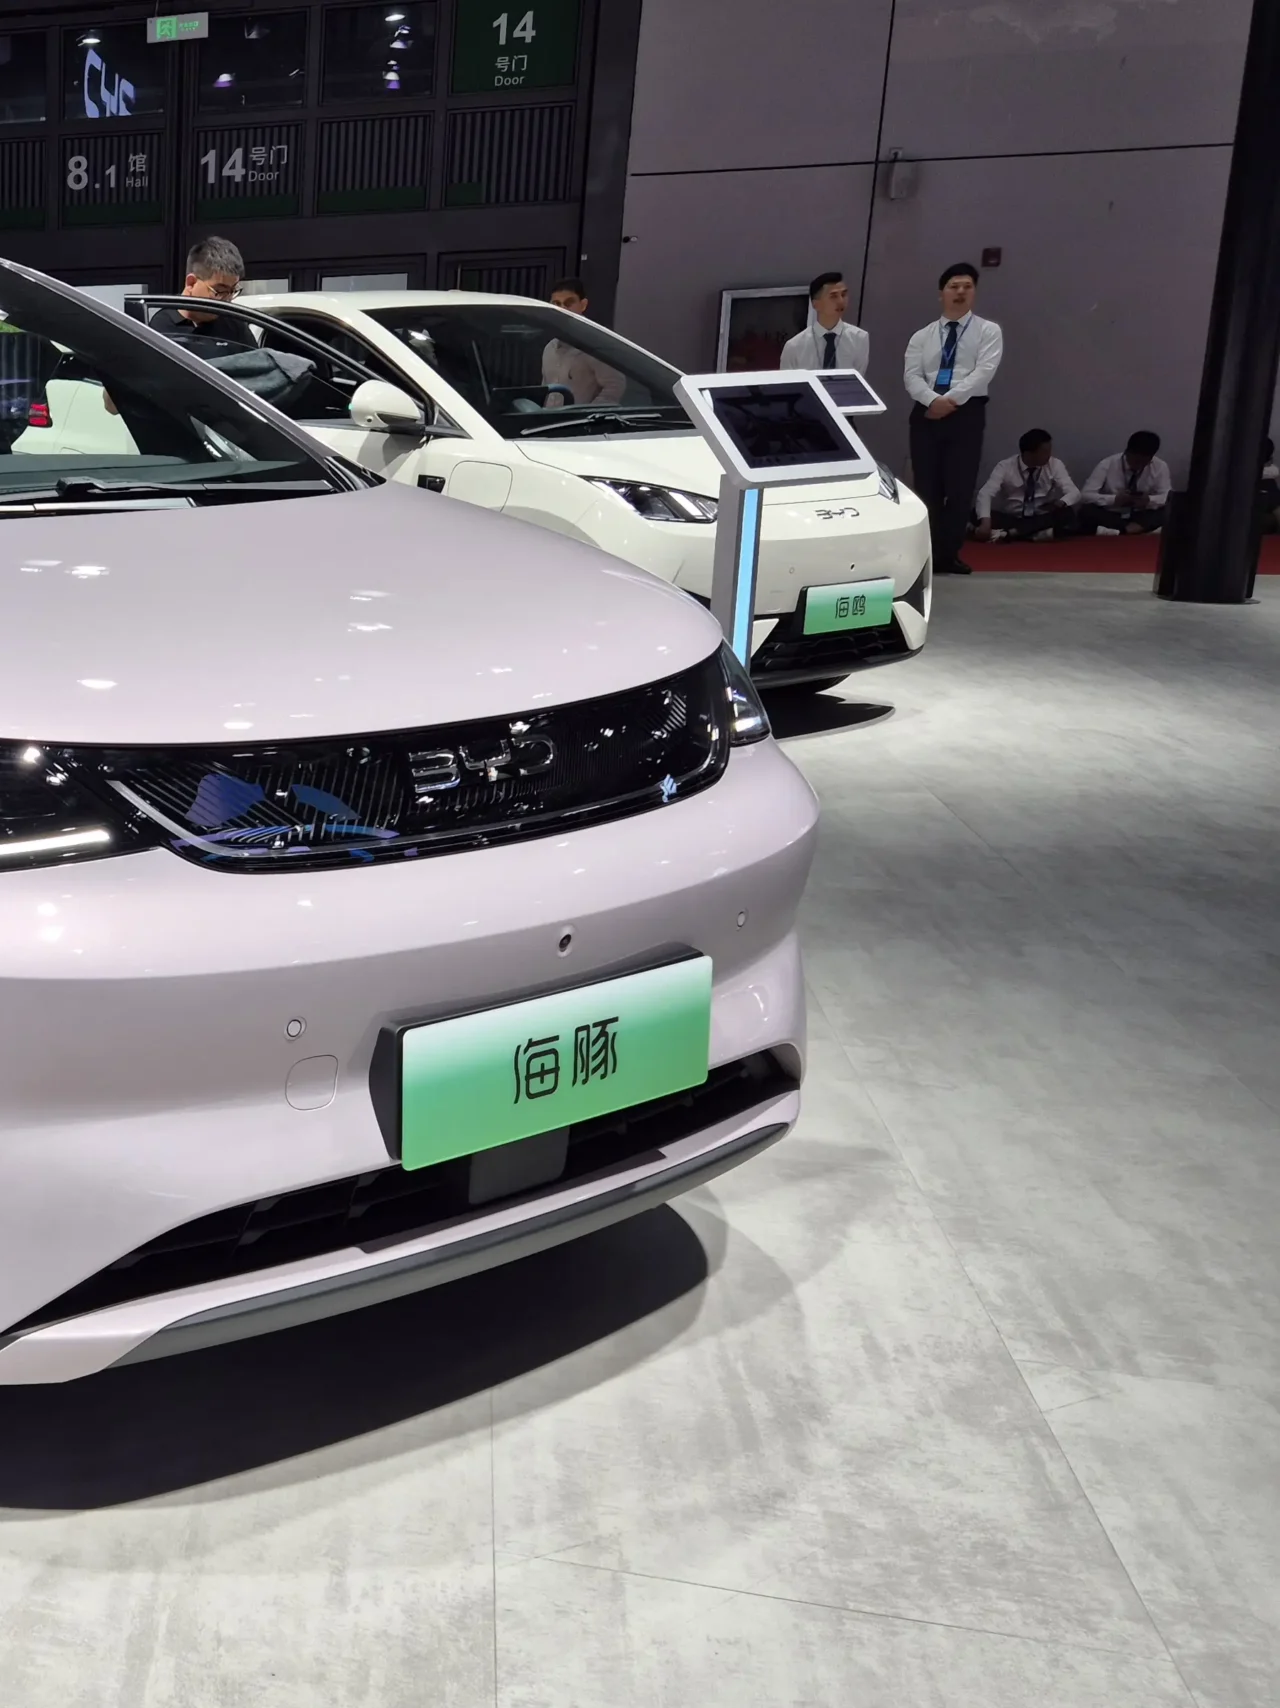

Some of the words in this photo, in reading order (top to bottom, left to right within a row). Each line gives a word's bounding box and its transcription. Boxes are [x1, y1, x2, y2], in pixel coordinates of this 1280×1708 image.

[492, 10, 536, 45] 14
[494, 54, 528, 73] 号门
[494, 75, 526, 87] Door
[128, 152, 147, 172] 馆
[200, 147, 246, 184] 14
[249, 144, 288, 166] 号门
[66, 155, 116, 190] 8.1
[125, 176, 149, 188] Hall
[248, 170, 280, 182] Door
[815, 507, 860, 520] BYD
[834, 594, 867, 619] 海鸥
[408, 733, 558, 794] BYD
[513, 1016, 619, 1105] 海豚
